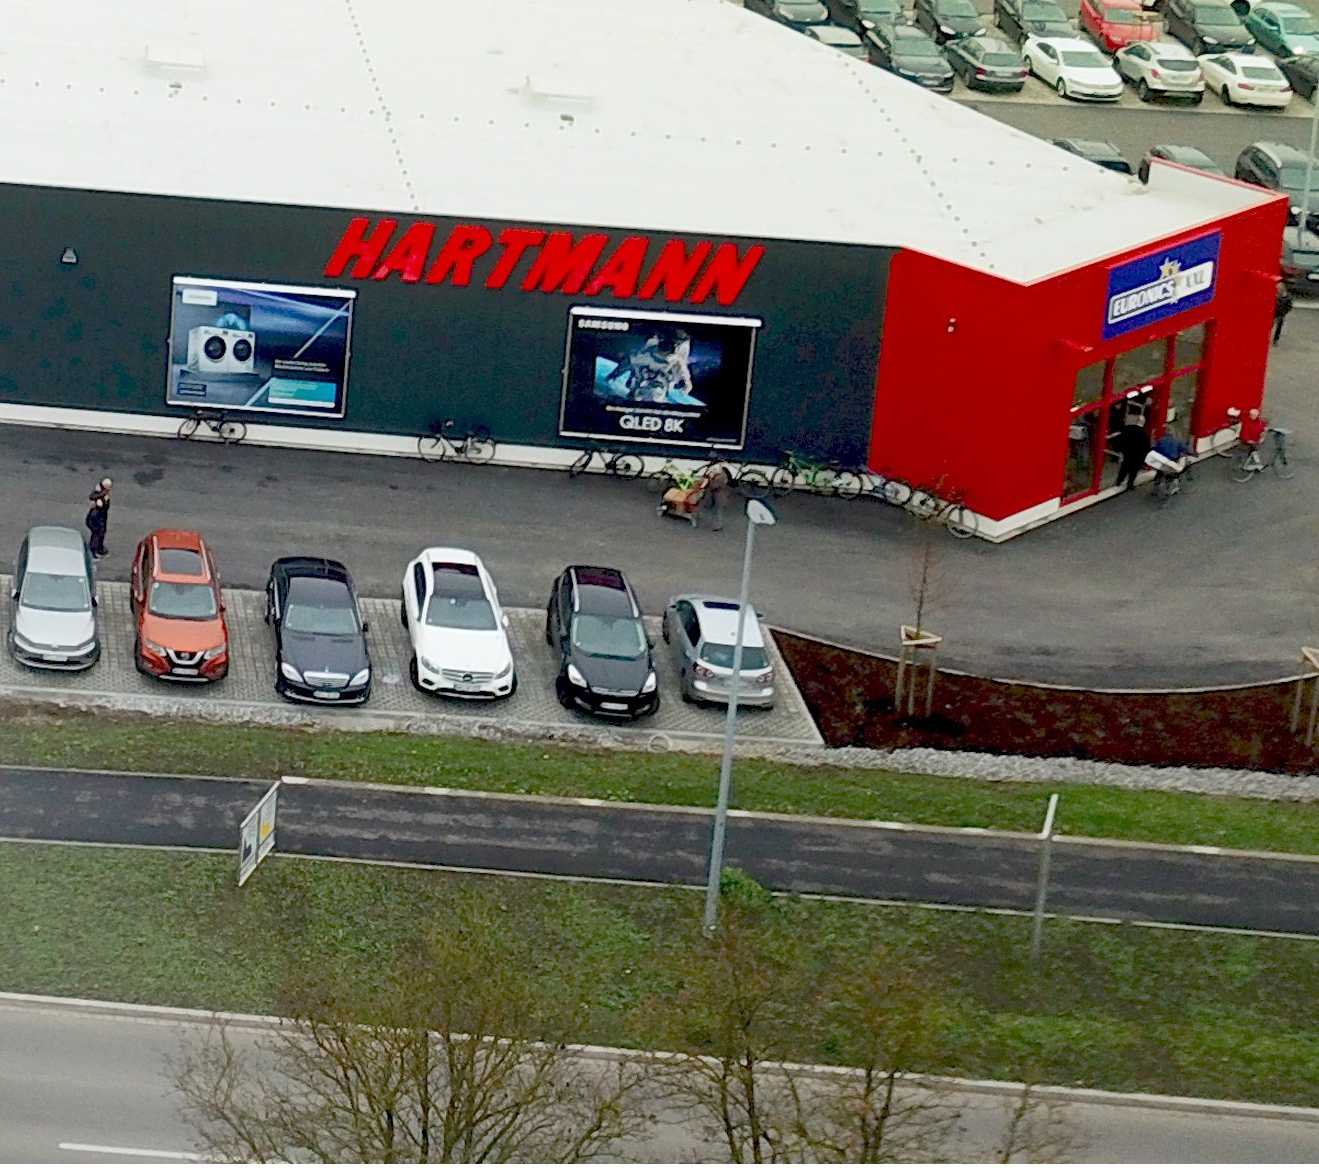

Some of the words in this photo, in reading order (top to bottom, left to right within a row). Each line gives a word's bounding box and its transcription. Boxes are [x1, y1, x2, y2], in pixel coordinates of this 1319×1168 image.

[323, 217, 766, 306] HARTMANN
[578, 319, 630, 332] SAMSUNG
[619, 415, 662, 432] QLED
[663, 418, 685, 433] 8K
